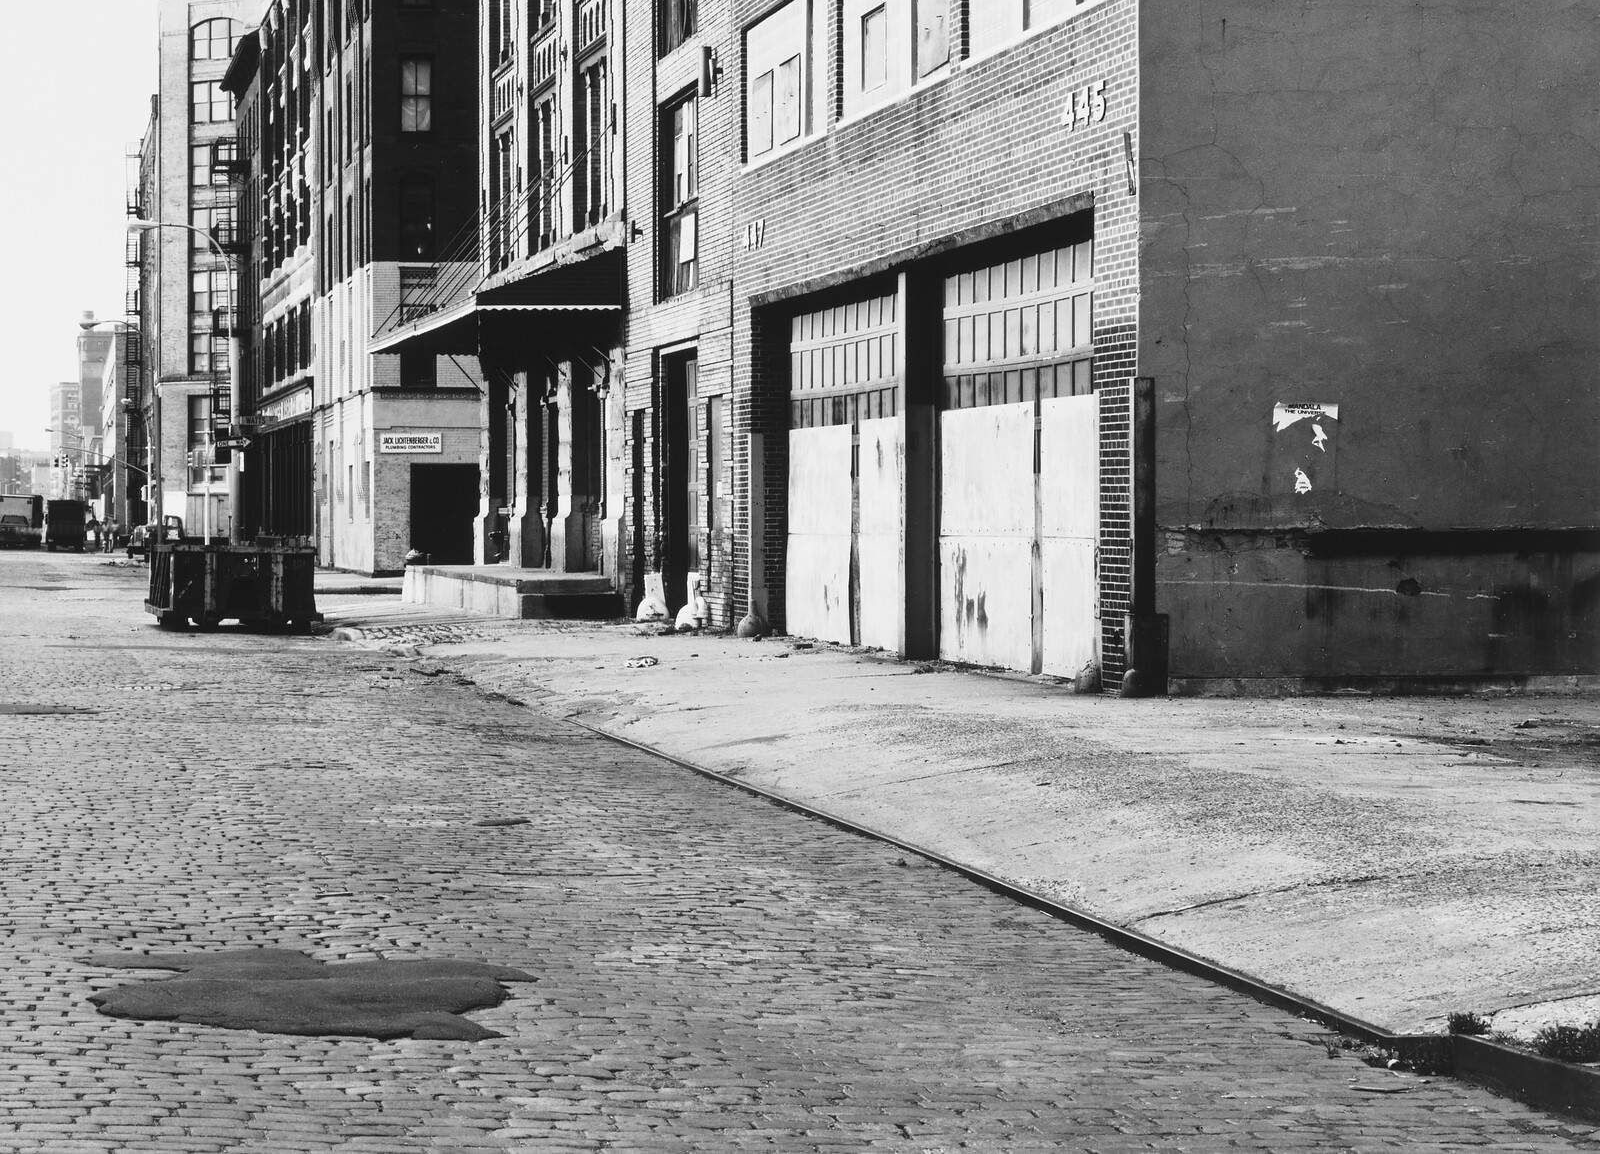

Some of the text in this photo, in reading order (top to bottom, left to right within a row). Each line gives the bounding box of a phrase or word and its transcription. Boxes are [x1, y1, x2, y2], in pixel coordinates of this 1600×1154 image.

[1061, 80, 1107, 133] 445
[246, 416, 266, 425] WATTS
[382, 436, 393, 444] JACK
